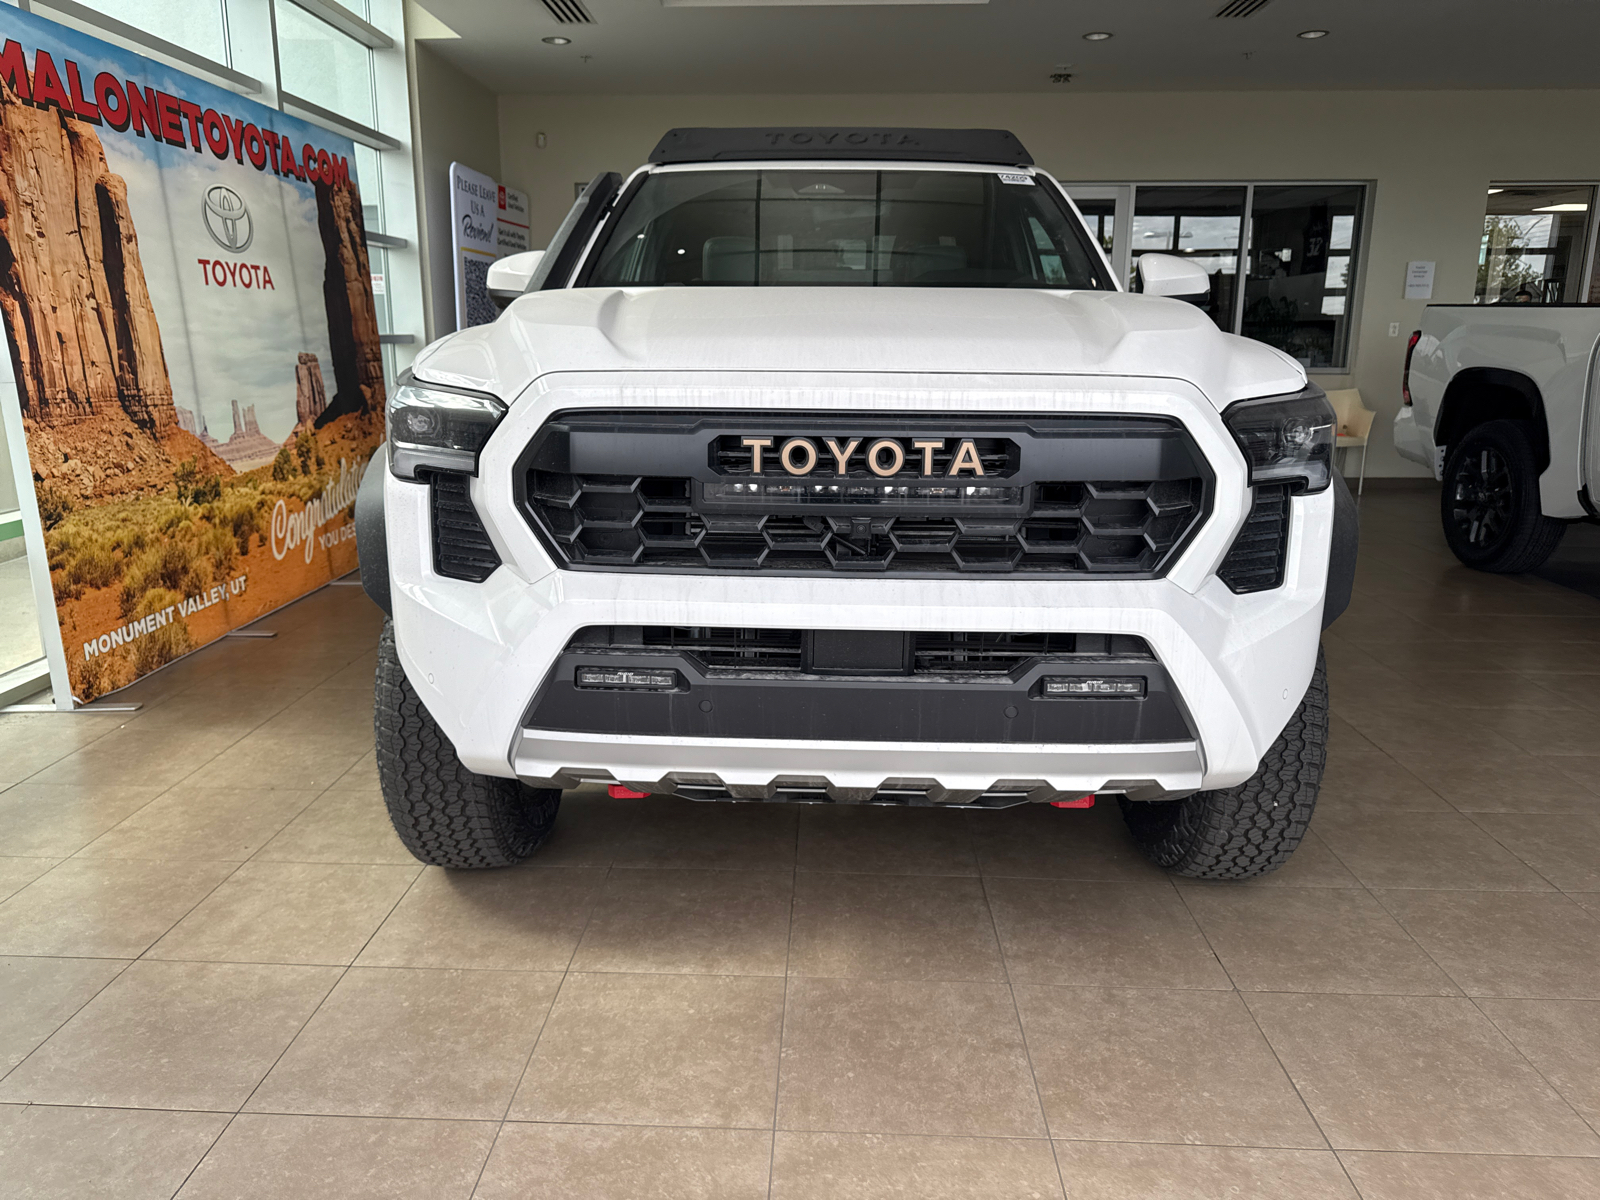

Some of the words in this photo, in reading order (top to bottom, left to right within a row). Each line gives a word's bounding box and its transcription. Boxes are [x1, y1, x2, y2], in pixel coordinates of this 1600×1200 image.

[765, 132, 920, 146] TOYOTA
[457, 175, 478, 197] PLEASE
[479, 184, 496, 203] LEAVE
[197, 258, 275, 290] TOYOTA
[741, 436, 986, 477] TOYOTA
[318, 529, 339, 551] YOU
[83, 605, 175, 662] MONUMENT
[177, 583, 230, 618] VALLEY,
[230, 575, 247, 595] UT
